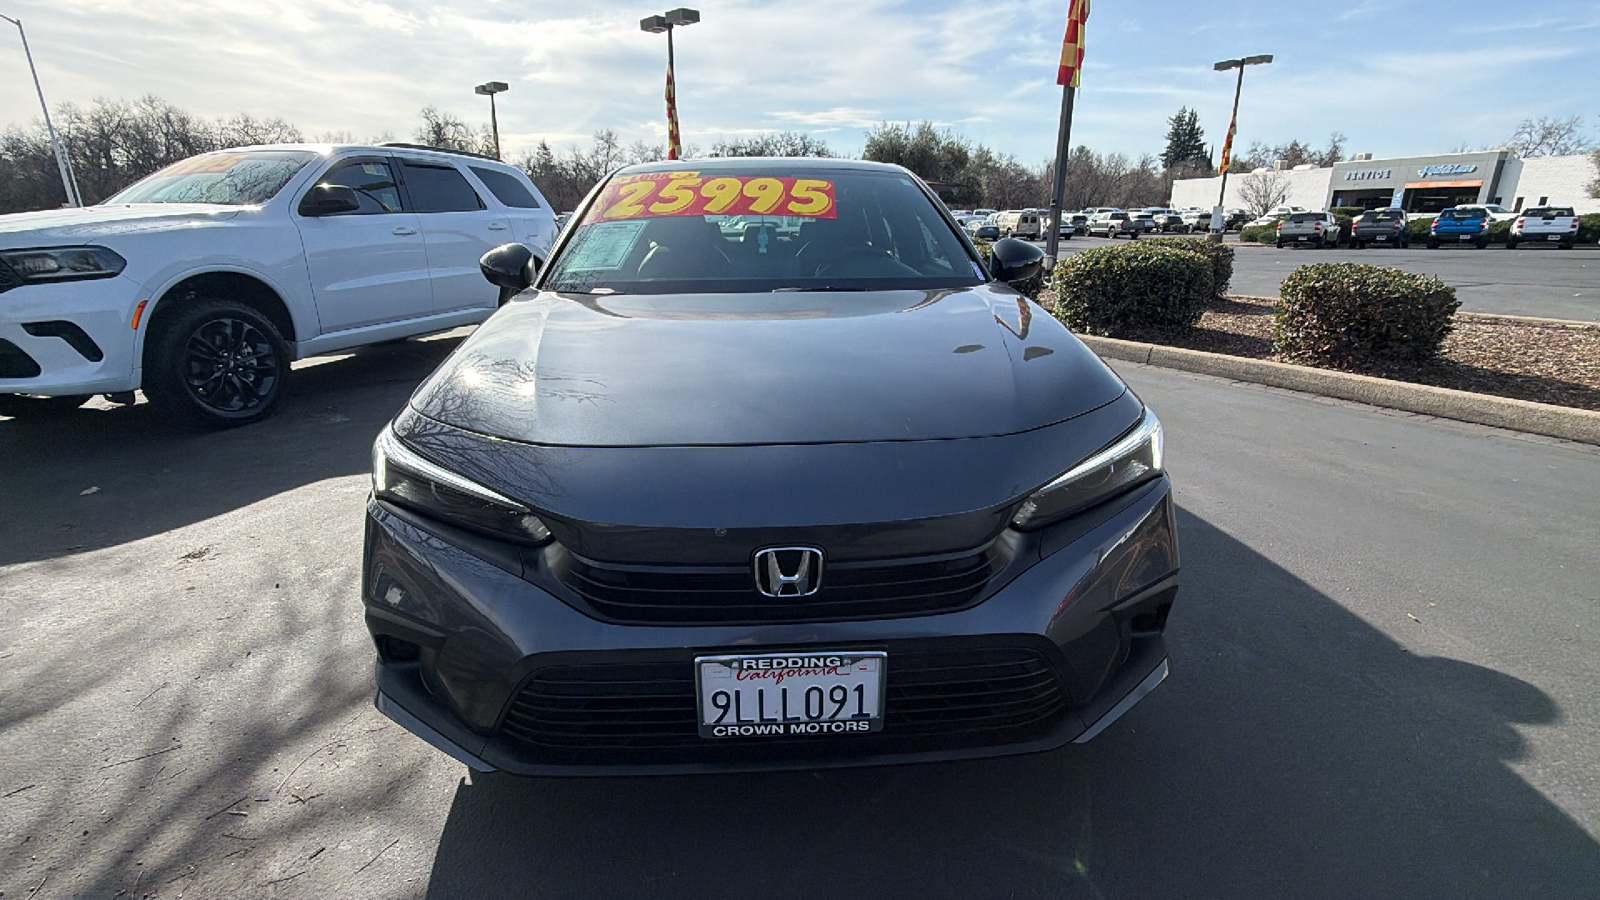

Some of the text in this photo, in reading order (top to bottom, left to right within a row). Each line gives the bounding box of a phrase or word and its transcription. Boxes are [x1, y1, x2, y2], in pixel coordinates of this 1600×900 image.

[1345, 170, 1391, 180] SERVICE
[742, 656, 841, 670] REDDING
[736, 665, 850, 685] California
[711, 684, 870, 724] 9LLL091
[713, 721, 870, 737] CROWN MOTORS
